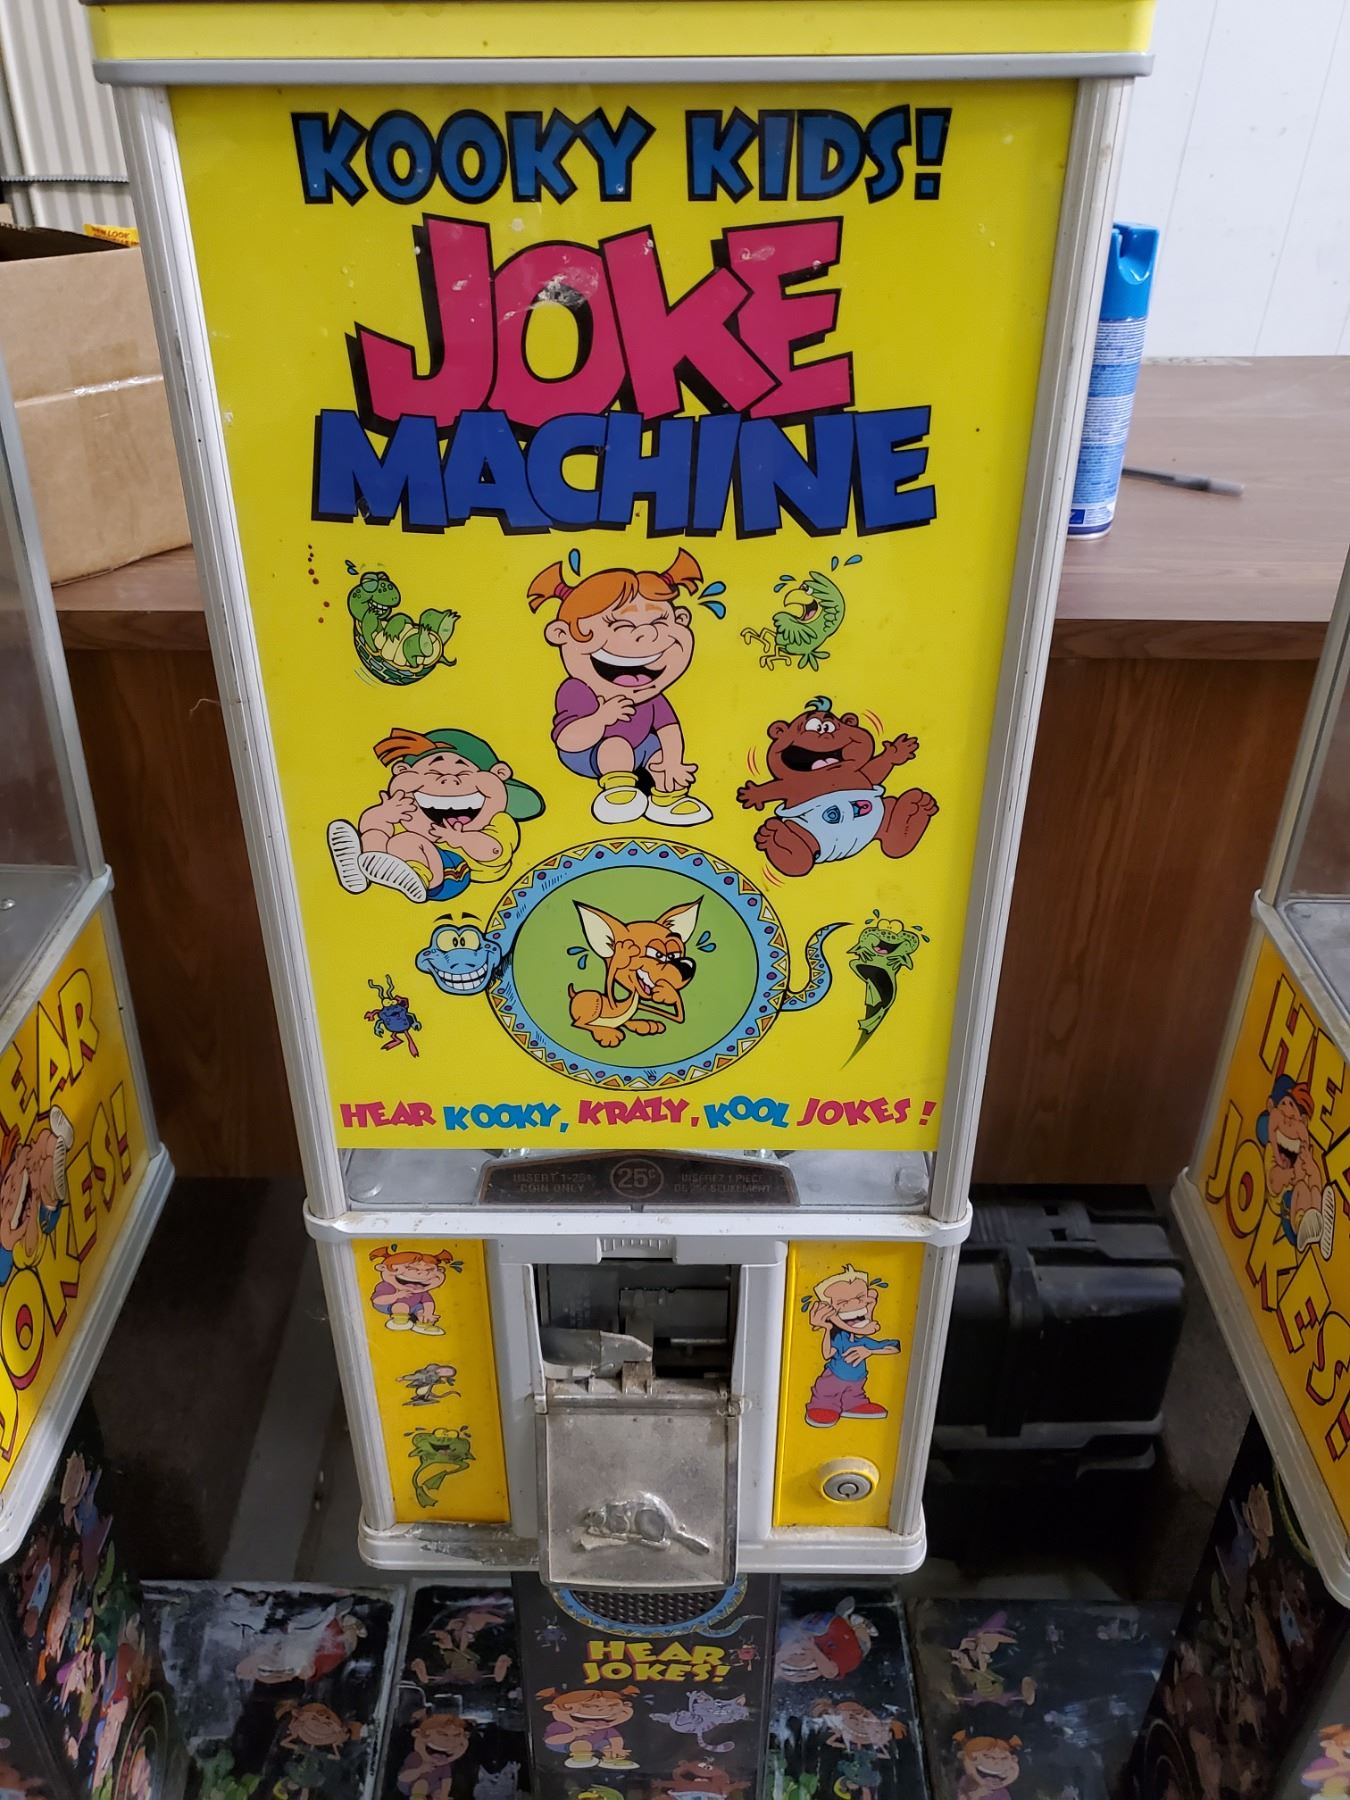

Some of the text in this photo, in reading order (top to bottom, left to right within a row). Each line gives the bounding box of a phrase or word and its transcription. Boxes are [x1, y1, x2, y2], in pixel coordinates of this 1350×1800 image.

[291, 104, 952, 205] KOOKY KIDS!
[345, 213, 855, 438] JOKE
[312, 404, 937, 539] MACHINE
[340, 1101, 437, 1128] HEAR
[443, 1102, 569, 1133] KOOKY,
[578, 1096, 699, 1127] KRAZY,
[704, 1095, 789, 1128] KOOL
[520, 1184, 584, 1193] COIN ONLY
[585, 1640, 726, 1665] HEAR
[582, 1662, 732, 1684] JOKES!
